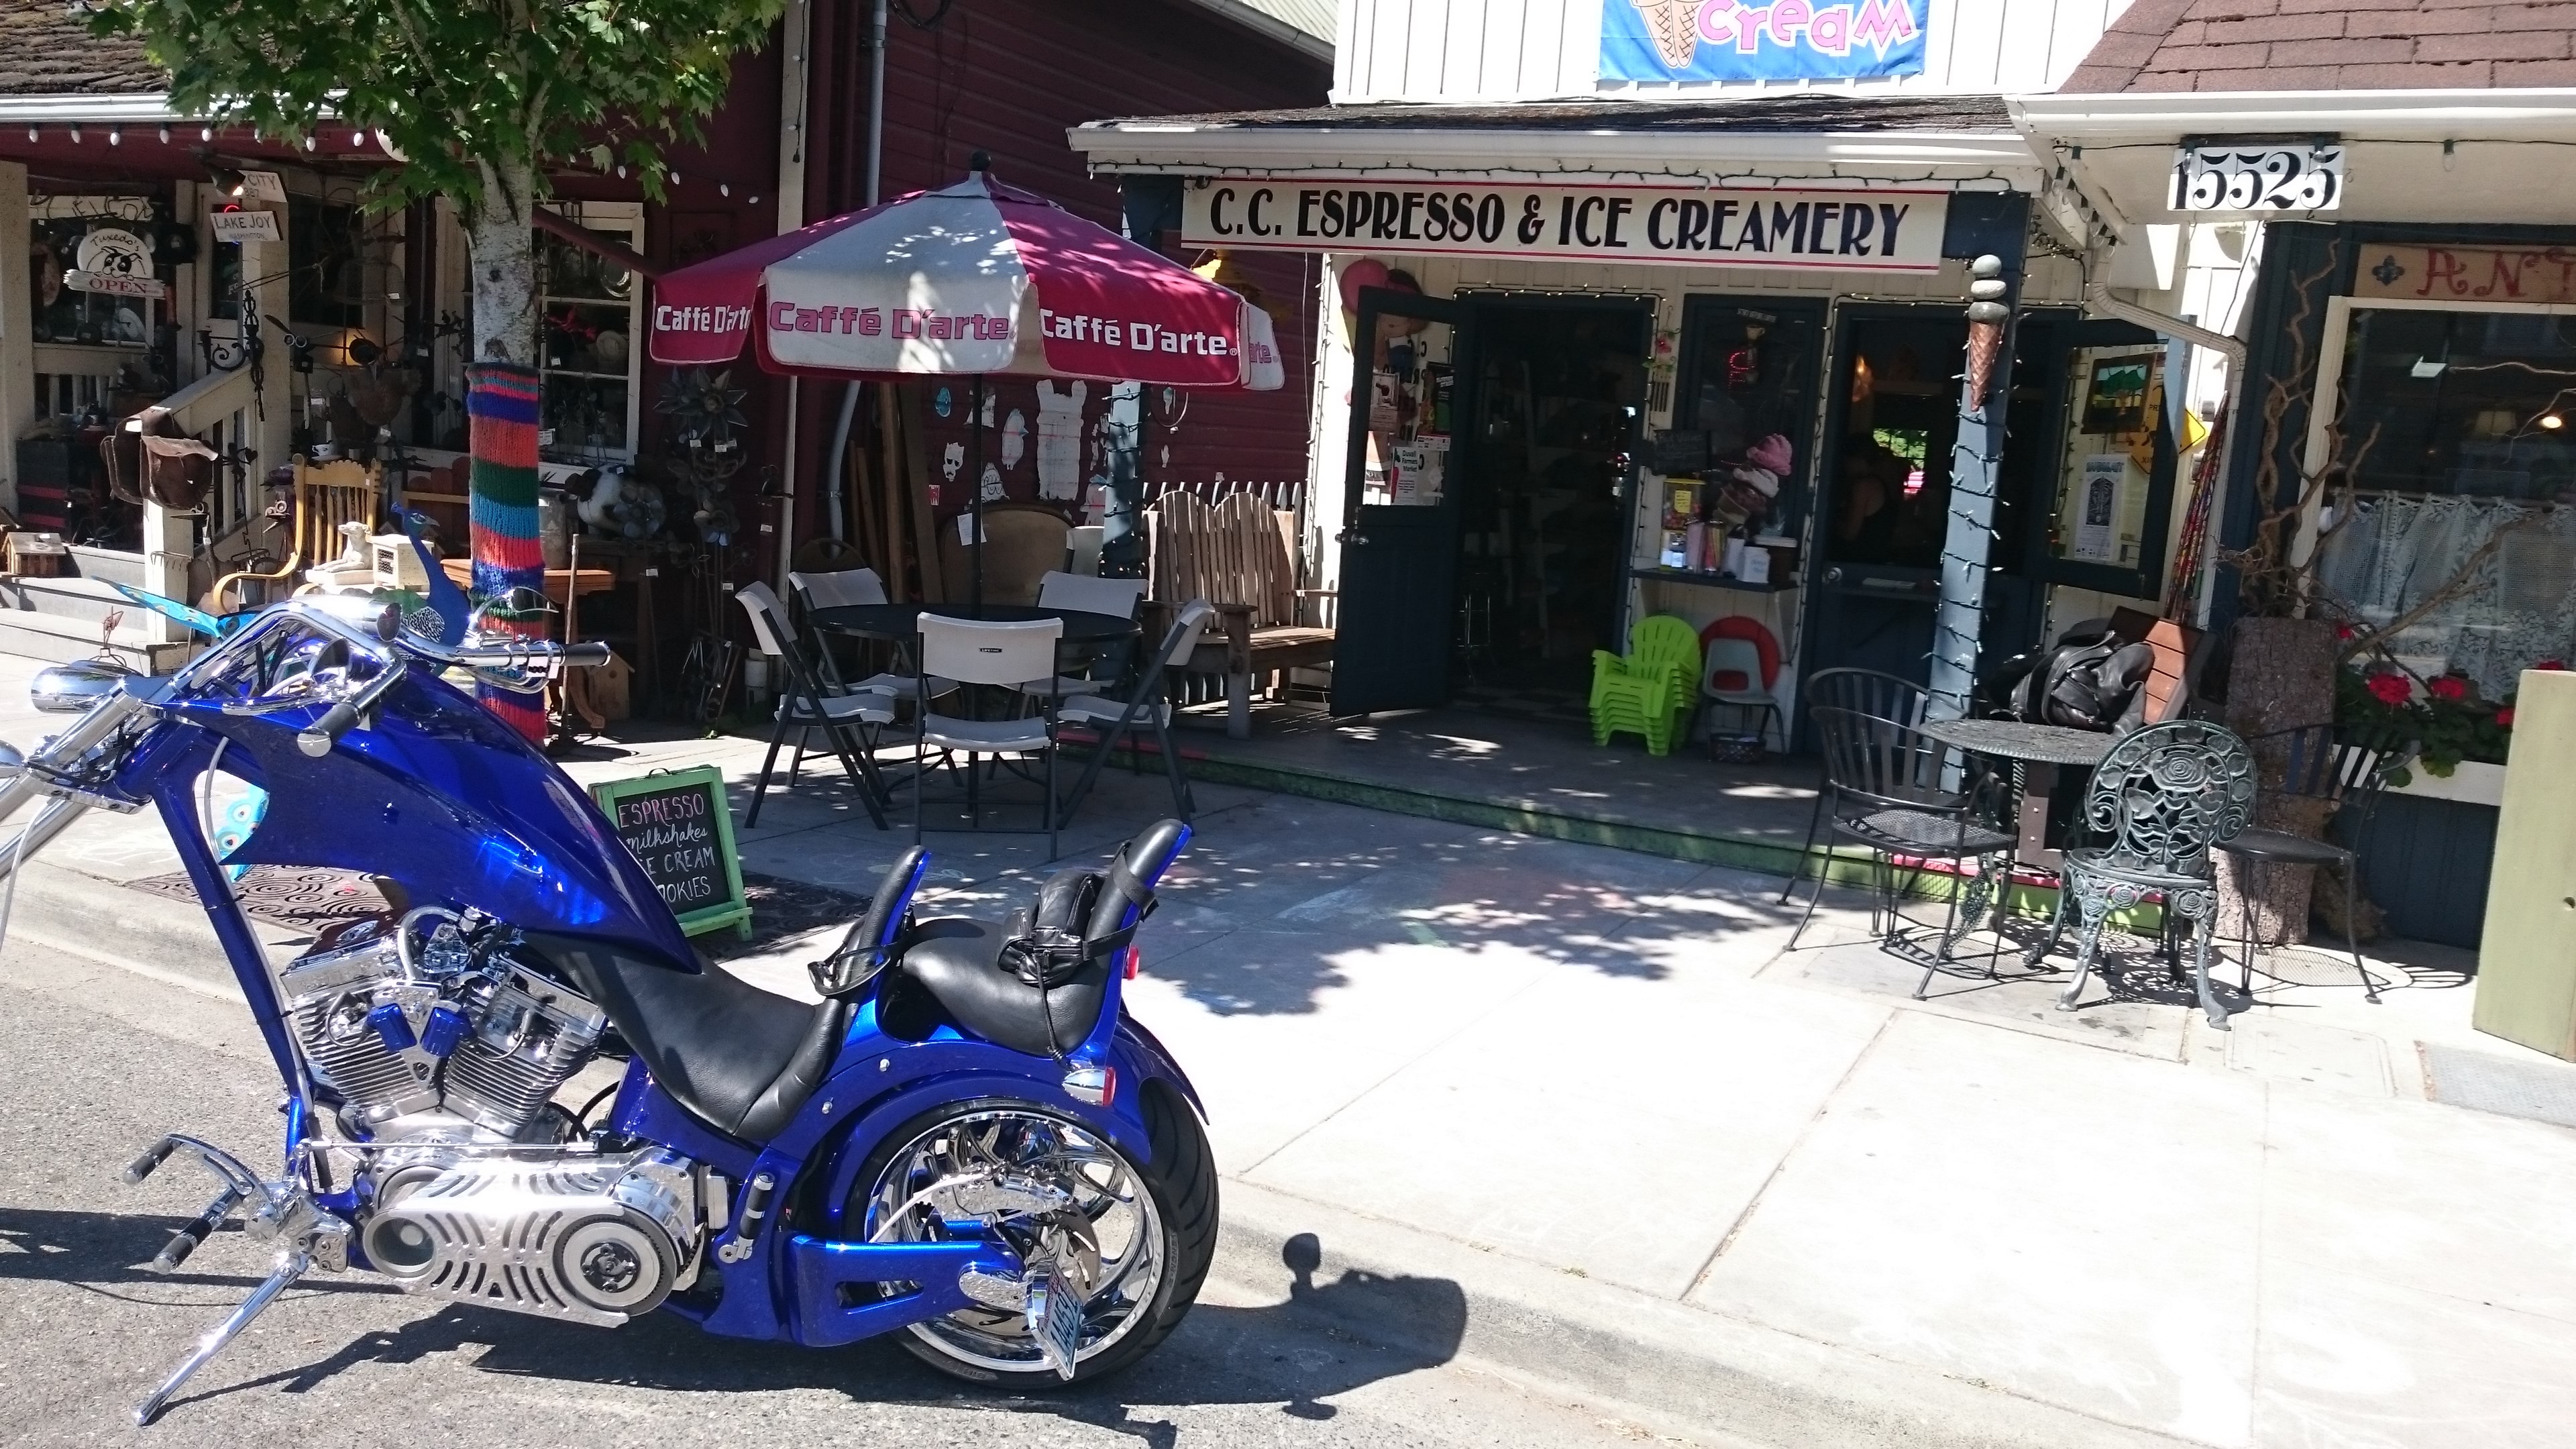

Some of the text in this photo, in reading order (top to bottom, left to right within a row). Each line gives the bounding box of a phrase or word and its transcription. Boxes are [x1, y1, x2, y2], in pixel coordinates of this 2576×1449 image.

[248, 173, 275, 190] CITY
[2174, 151, 2341, 210] 15525
[213, 215, 270, 229] LAKE JOY
[1210, 188, 1910, 256] C.C. ESPRESSO & ICE CREAMERY
[90, 234, 140, 252] Tuxedo's
[89, 278, 148, 294] OPEN
[655, 305, 710, 331] Caffé
[770, 301, 881, 335] Caffé
[1040, 308, 1121, 346] Caffé
[618, 793, 704, 828] ESPRESSO
[663, 846, 716, 873] CREAM
[657, 875, 711, 903] OOKIES
